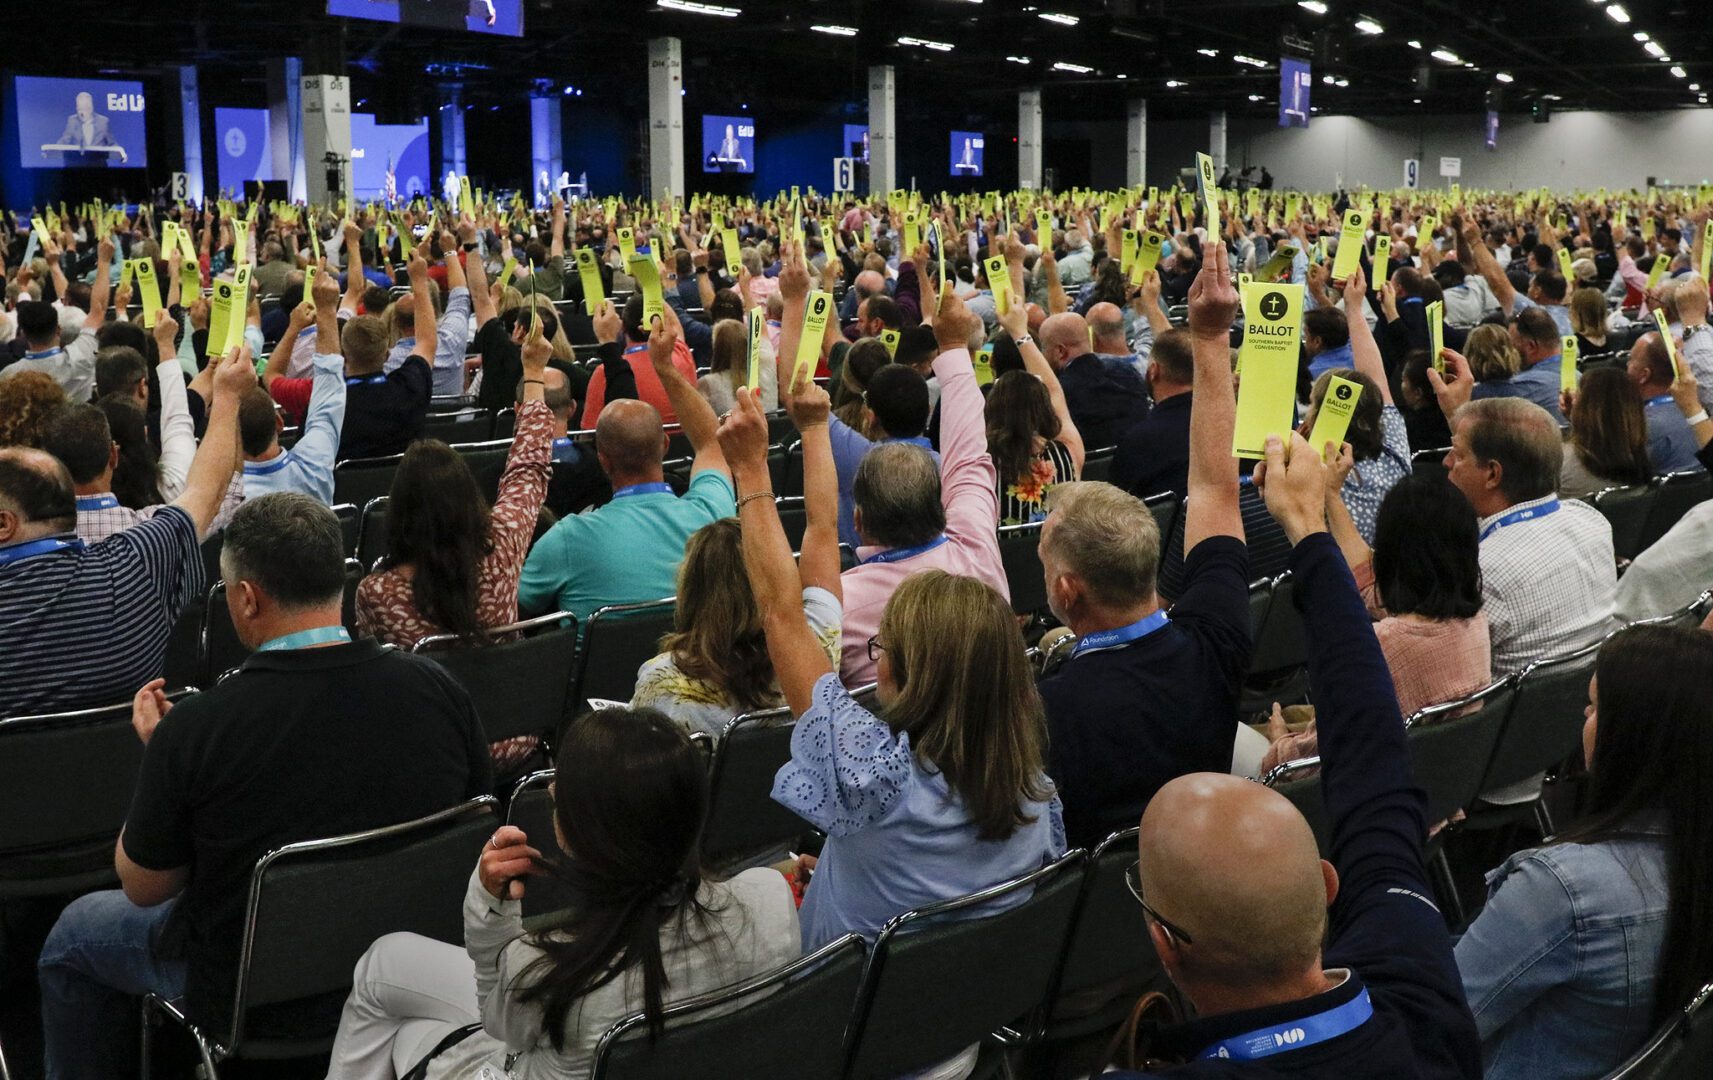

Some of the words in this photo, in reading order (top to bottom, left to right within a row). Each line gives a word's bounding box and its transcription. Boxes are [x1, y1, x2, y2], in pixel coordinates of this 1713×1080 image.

[107, 93, 128, 111] Ed
[839, 159, 849, 190] 6
[1408, 161, 1416, 187] 9
[177, 174, 186, 199] 3
[1249, 324, 1294, 337] BALLOT
[1326, 398, 1352, 411] BALLOT
